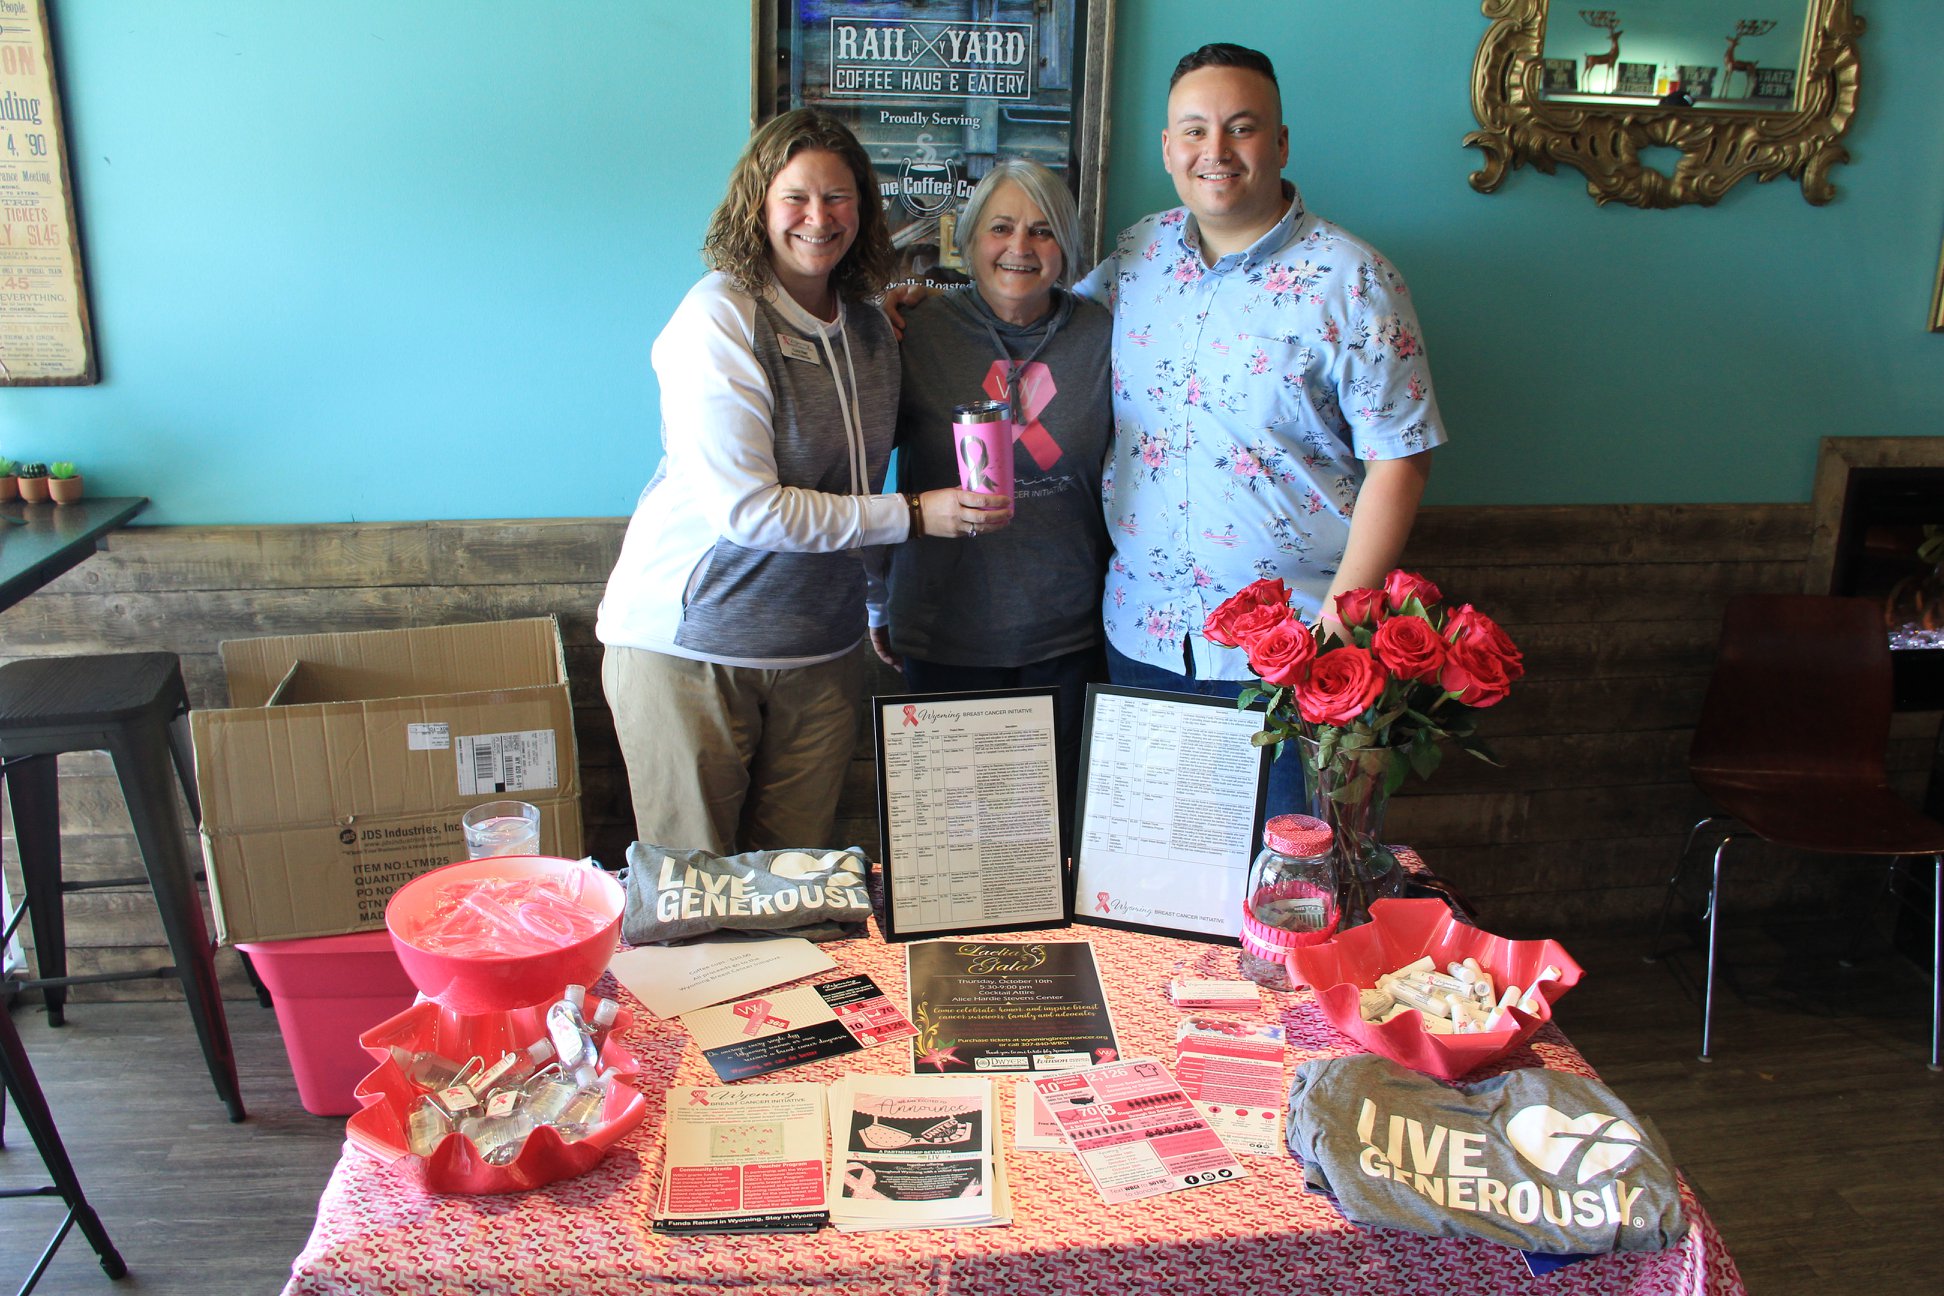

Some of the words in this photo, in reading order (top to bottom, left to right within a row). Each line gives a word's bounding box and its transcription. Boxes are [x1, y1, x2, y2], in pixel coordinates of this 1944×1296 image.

[837, 25, 913, 62] RAIL
[947, 29, 1026, 65] YARD
[836, 71, 893, 90] COFFEE
[902, 73, 942, 91] HAUS
[968, 75, 1025, 94] EATERY
[880, 111, 929, 128] Proudly
[932, 112, 980, 129] Serving
[880, 181, 899, 196] ne
[903, 177, 953, 195] Coffee
[5, 208, 48, 222] TICKETS
[918, 709, 961, 724] Wyoming
[362, 829, 382, 840] JDS
[444, 823, 464, 832] Inc.
[353, 863, 380, 874] ITEM
[657, 855, 757, 899] LIVE
[355, 871, 418, 885] QUANTITY:
[357, 889, 373, 897] PO
[358, 899, 382, 910] CTN
[1111, 898, 1152, 917] Wyoming
[1154, 909, 1175, 917] BREAST
[1176, 912, 1198, 920] CANCER
[1199, 915, 1225, 923] INITIATIVE
[360, 911, 385, 921] MAD
[967, 957, 1029, 975] Gala
[1038, 1082, 1060, 1094] 10
[1087, 1069, 1128, 1081] 2,126
[710, 1090, 795, 1101] Wyoming
[875, 1099, 968, 1115] Announce
[1078, 1107, 1097, 1116] 70
[1100, 1104, 1116, 1116] 8
[924, 1119, 958, 1139] UNITED
[1357, 1098, 1488, 1177] LIVE
